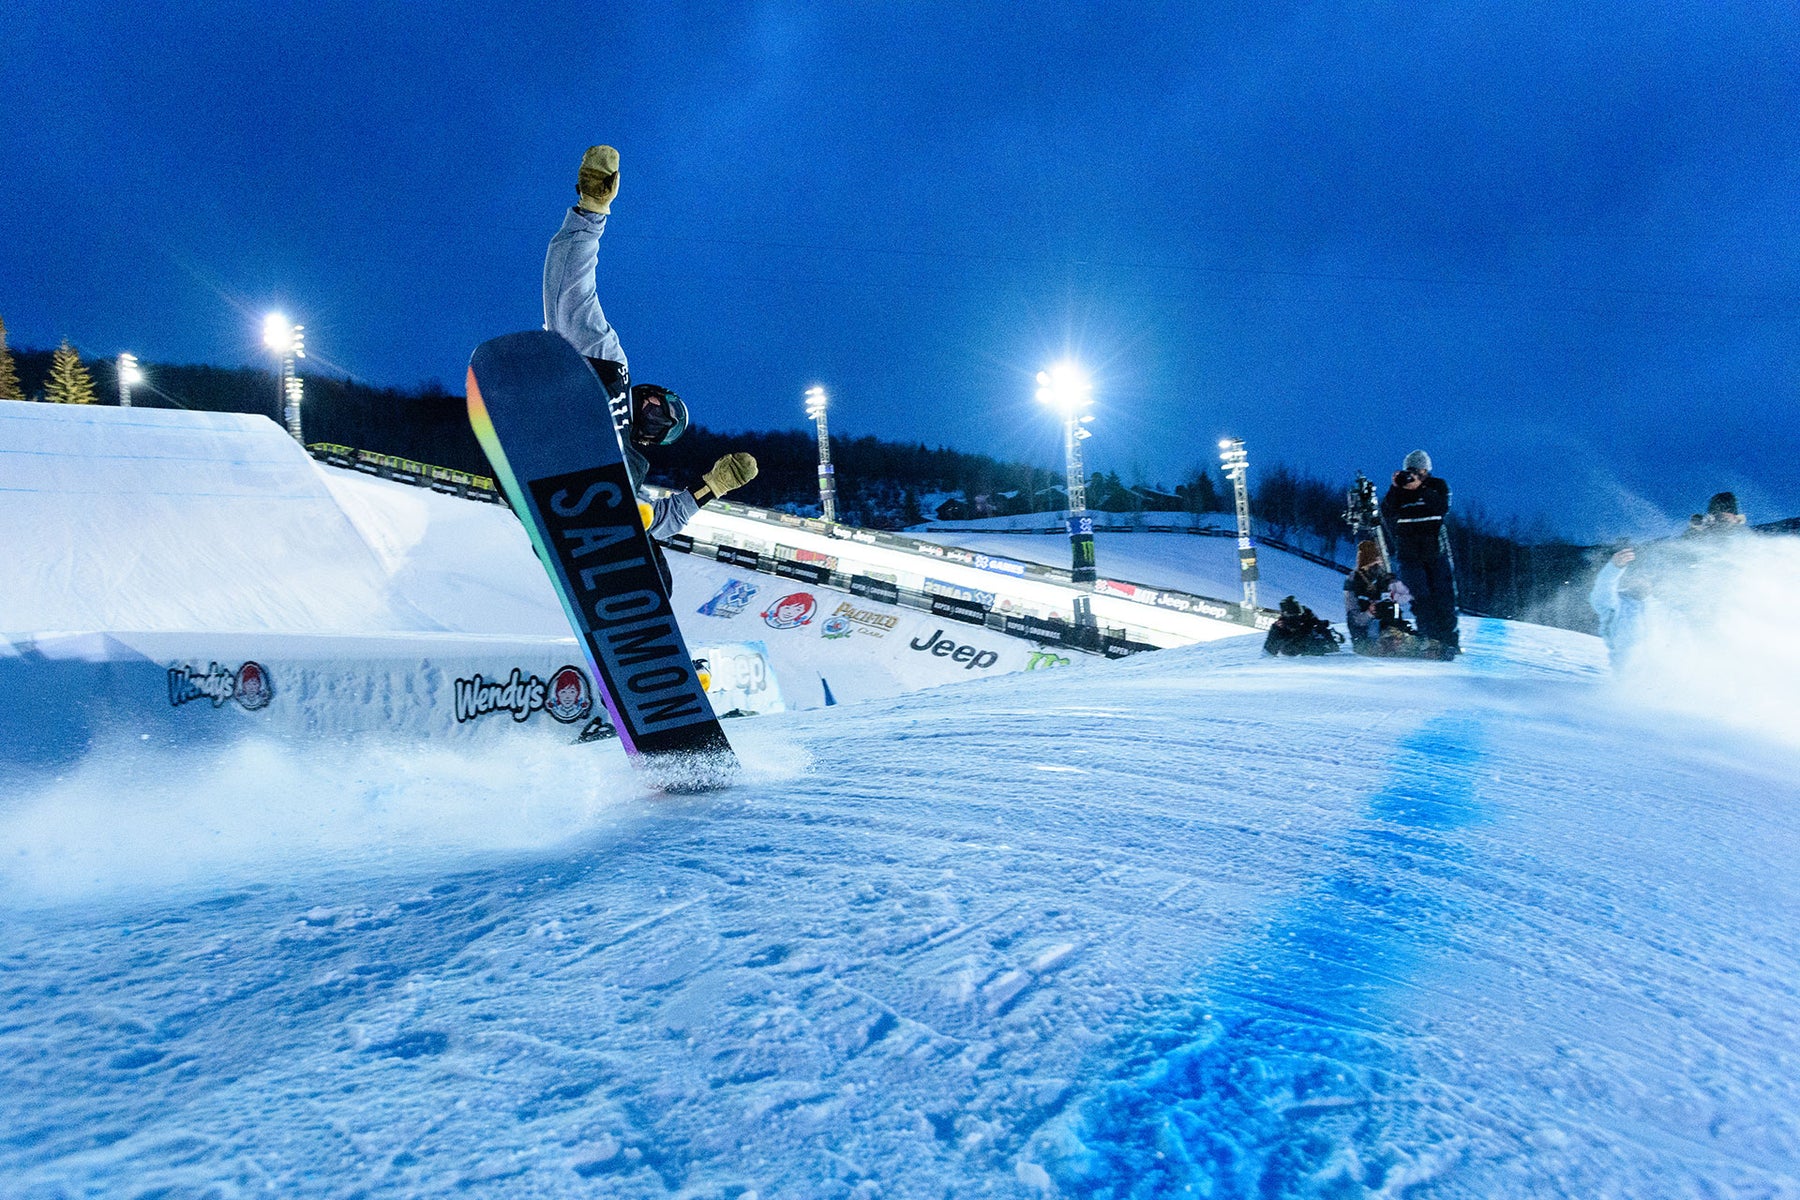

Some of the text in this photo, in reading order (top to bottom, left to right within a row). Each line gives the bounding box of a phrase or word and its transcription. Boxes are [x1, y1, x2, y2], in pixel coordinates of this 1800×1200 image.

[550, 481, 701, 726] SALOMON
[1158, 593, 1190, 611] Jeep
[1193, 601, 1227, 619] Jeep
[909, 629, 999, 670] Jeep
[454, 667, 545, 723] Wendy's
